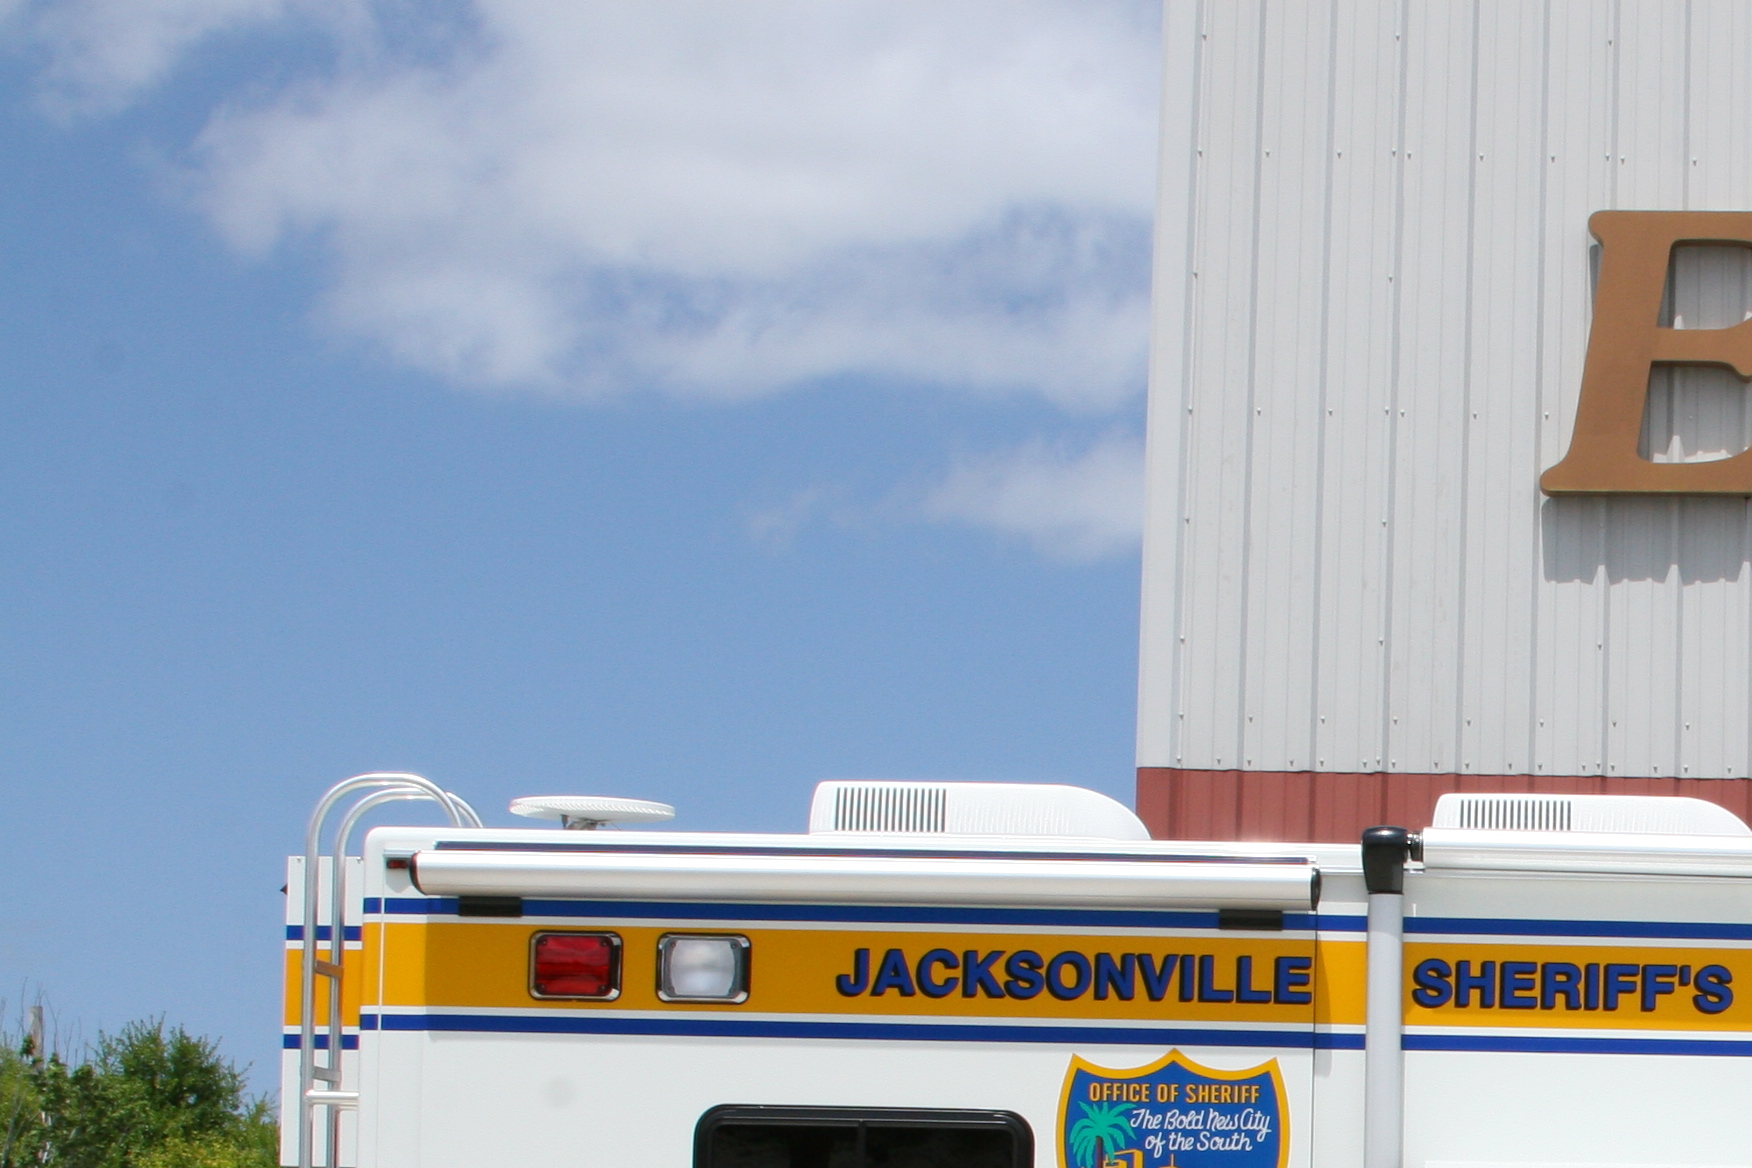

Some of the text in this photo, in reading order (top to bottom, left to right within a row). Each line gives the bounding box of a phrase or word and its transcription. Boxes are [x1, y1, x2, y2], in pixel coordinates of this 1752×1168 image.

[836, 947, 1313, 1004] JACKSONVILLE
[1412, 958, 1734, 1015] SHERIFF'S
[1089, 1082, 1261, 1104] OFFICE OF SHERIFF
[1130, 1108, 1272, 1143] The Bold New City
[1145, 1131, 1253, 1158] of the South
